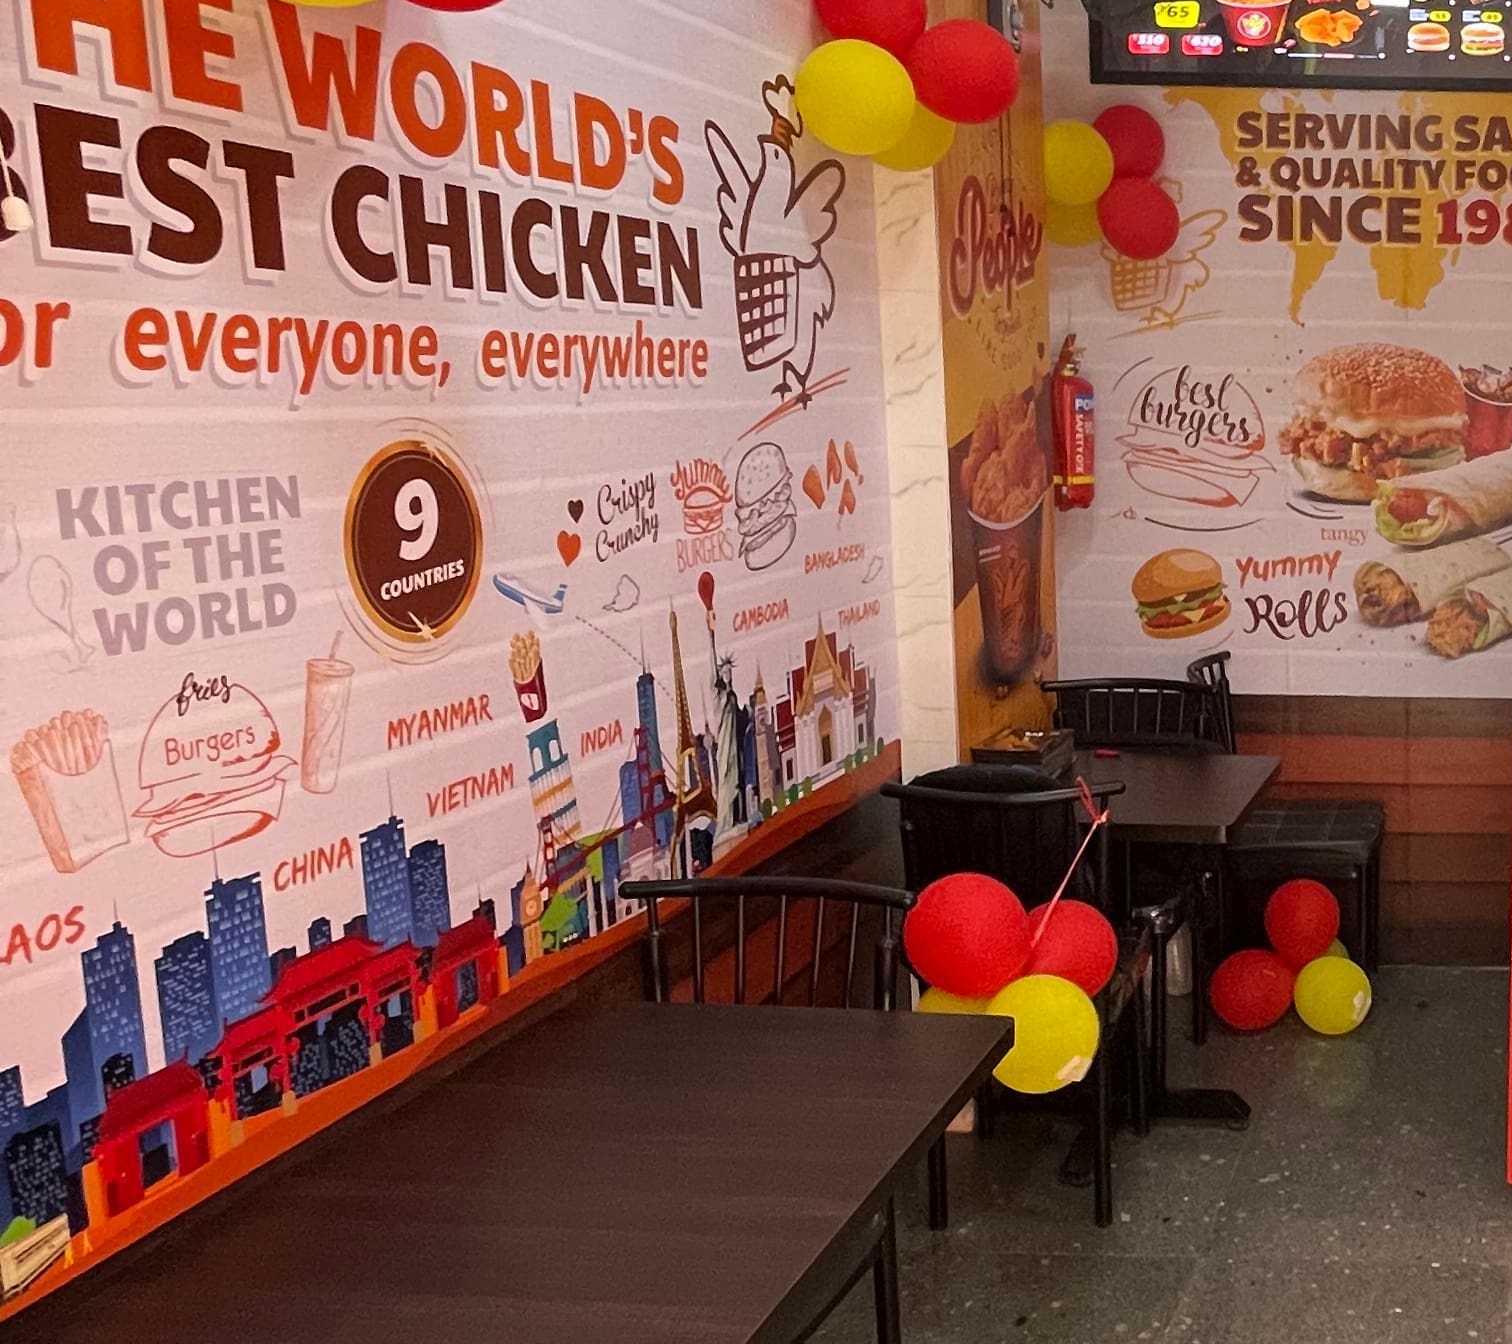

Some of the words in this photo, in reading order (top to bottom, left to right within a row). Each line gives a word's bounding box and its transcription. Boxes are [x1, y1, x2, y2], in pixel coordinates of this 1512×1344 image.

[1236, 111, 1451, 152] SERVING
[1234, 157, 1261, 187] &
[1269, 155, 1443, 193] QUALITY
[0, 102, 294, 272] EST
[330, 163, 702, 309] CHICKEN
[1237, 196, 1421, 243] SINCE
[0, 298, 71, 368] or
[125, 307, 450, 394] everyone,
[482, 320, 708, 393] everywhere
[1140, 386, 1252, 448] burgers
[56, 475, 302, 540] KITCHEN
[393, 478, 440, 561] 9
[597, 472, 655, 525] Crispy
[596, 509, 658, 562] Crunchy
[676, 528, 734, 573] BURGERS
[804, 543, 865, 574] BANGLADESH
[1320, 527, 1368, 546] tangy
[93, 541, 170, 597] OF
[184, 529, 286, 584] THE
[380, 558, 466, 602] COUNTRIES
[93, 582, 299, 657] WORLD
[733, 598, 789, 632] CAMBODIA
[838, 600, 880, 630] THAILAND
[1243, 588, 1348, 640] Rolls
[176, 672, 231, 716] fries
[164, 726, 255, 765] Burgers
[387, 693, 492, 750] MYANMAR
[580, 719, 623, 757] INDIA
[426, 763, 514, 817] VIETNAM
[273, 837, 354, 893] CHINA
